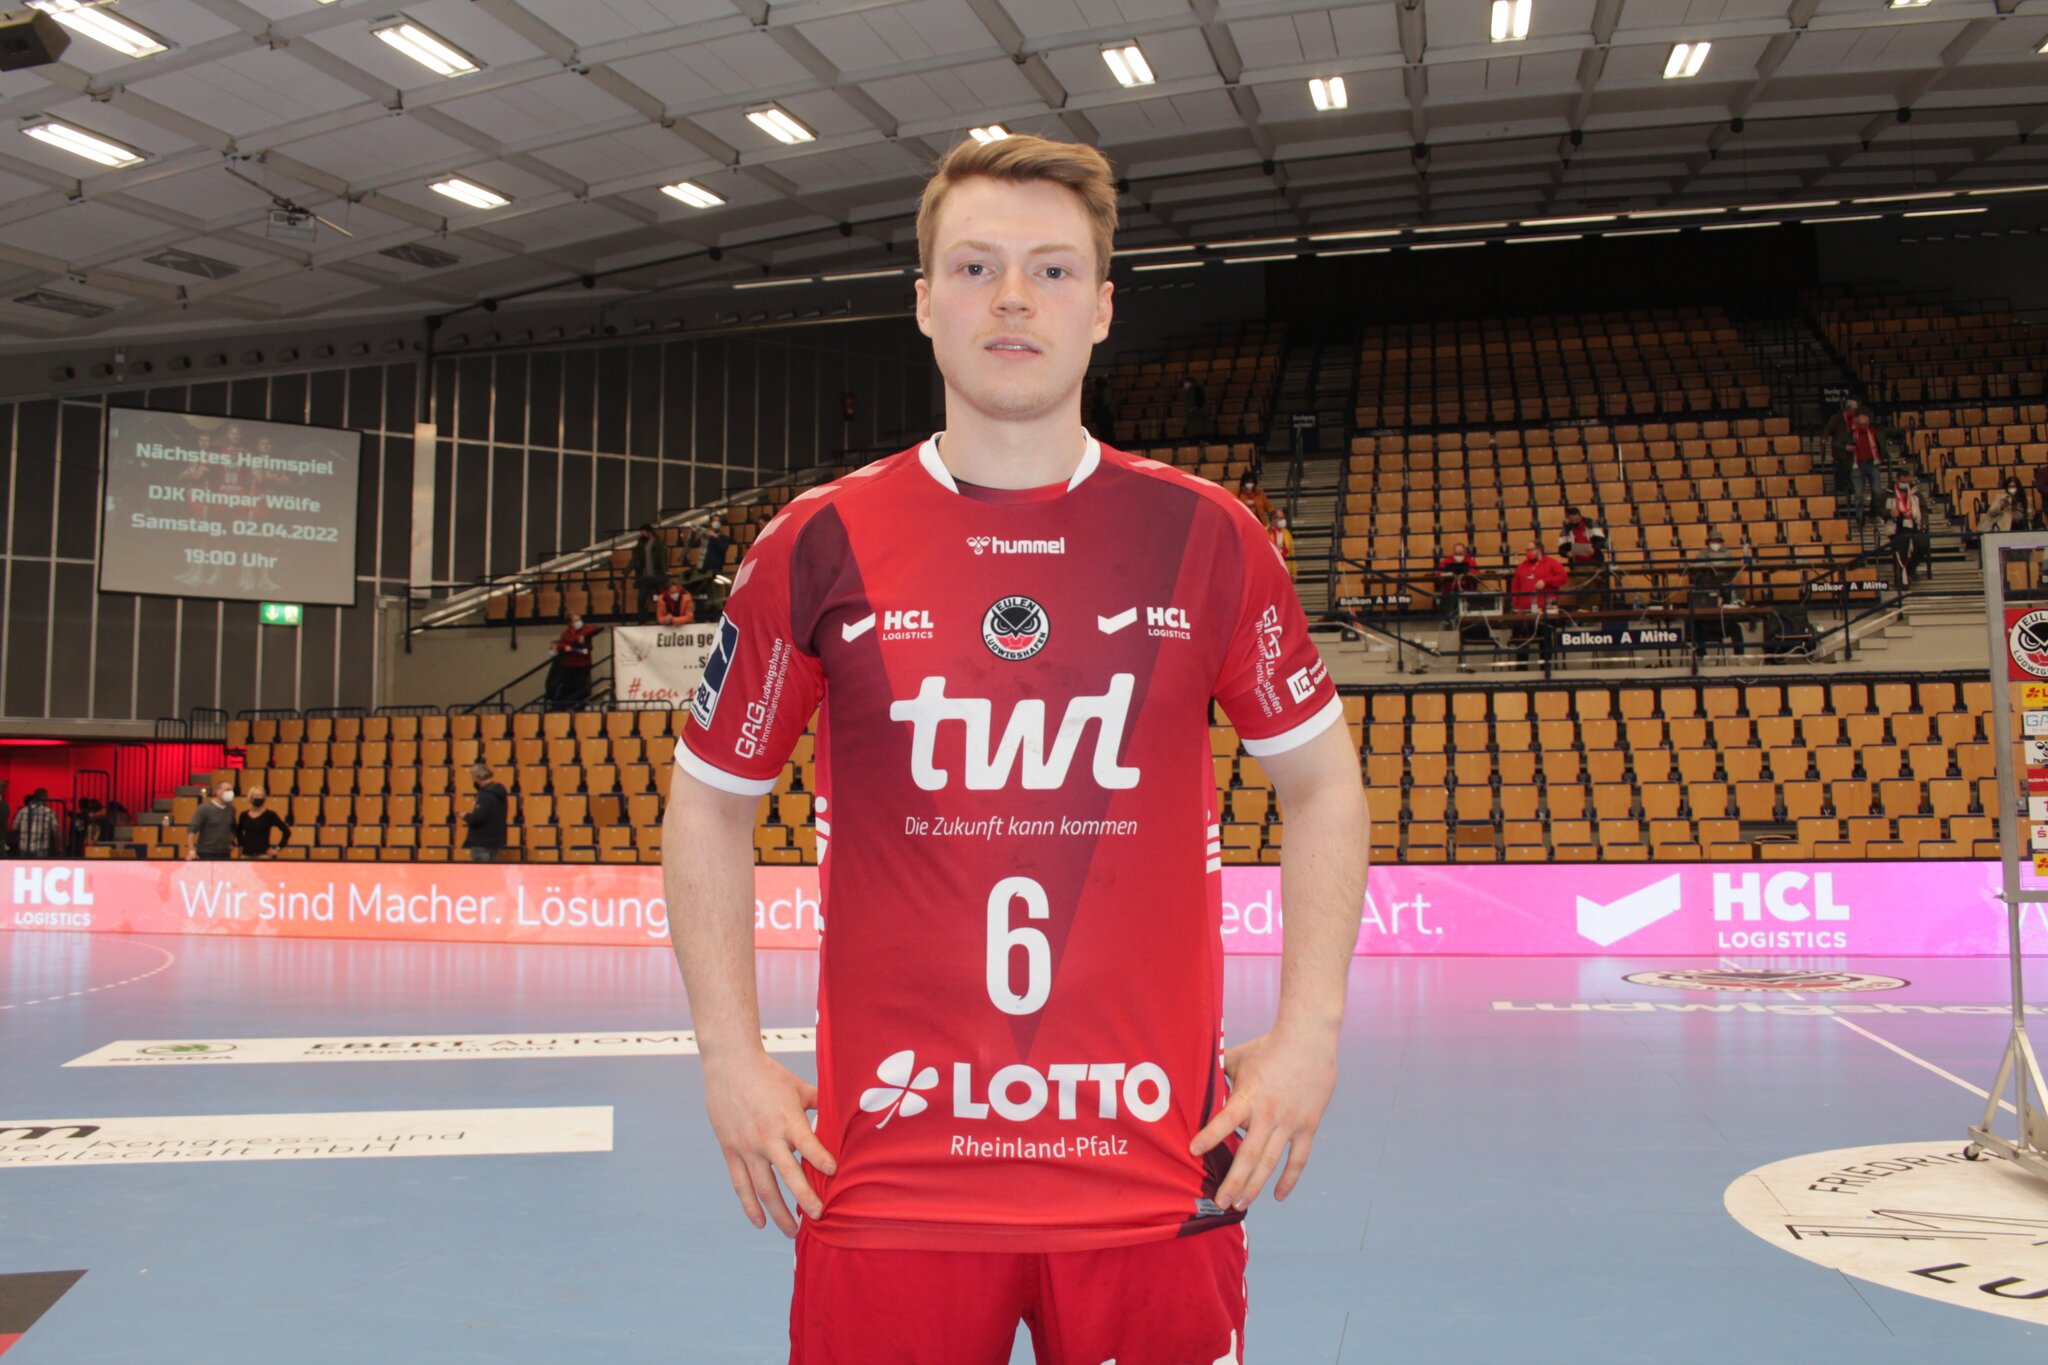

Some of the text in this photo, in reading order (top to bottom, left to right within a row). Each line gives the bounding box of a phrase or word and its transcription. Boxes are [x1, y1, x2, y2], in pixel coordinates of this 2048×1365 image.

[136, 442, 334, 476] Nächstes Heimspiel
[148, 485, 321, 513] DJK Rimpar Wölfe
[232, 520, 339, 542] 02.04.2022
[992, 536, 1065, 554] hummel
[184, 549, 278, 568] 19:00 Uhr
[1849, 582, 1858, 590] A
[1863, 581, 1888, 590] Mitte
[995, 598, 1036, 611] EULEN
[1375, 595, 1384, 604] A
[1387, 595, 1412, 604] Mtte
[883, 609, 935, 631] HCL
[1146, 606, 1191, 630] HCL
[2022, 612, 2048, 627] EUL
[656, 632, 714, 648] Eulen ge
[882, 629, 934, 641] LOGISTICS
[985, 632, 1046, 659] LUDWIGSHAFEN
[1147, 628, 1191, 641] LOGISTICS
[1561, 630, 1678, 646] Balkon A Mitte
[2013, 650, 2048, 676] LUDWIG
[735, 638, 783, 759] GAG Ludwigshafen
[905, 816, 1138, 840] Die Zukunft kann kommen
[13, 866, 93, 905] HCL
[1712, 870, 1850, 922] HCL
[15, 911, 92, 927] LOGISTICS
[180, 880, 248, 920] Wir
[258, 881, 334, 921] sind
[349, 883, 501, 925] Macher.
[517, 885, 670, 938] Lösung
[986, 876, 1052, 1016] 6
[1718, 931, 1848, 949] LOGISTICS
[953, 1061, 1171, 1122] LOTTO
[0, 1147, 252, 1163] sellschaft
[950, 1135, 1128, 1158] Rheinland-Pfalz
[1808, 1151, 2006, 1195] FRIEDRIC
